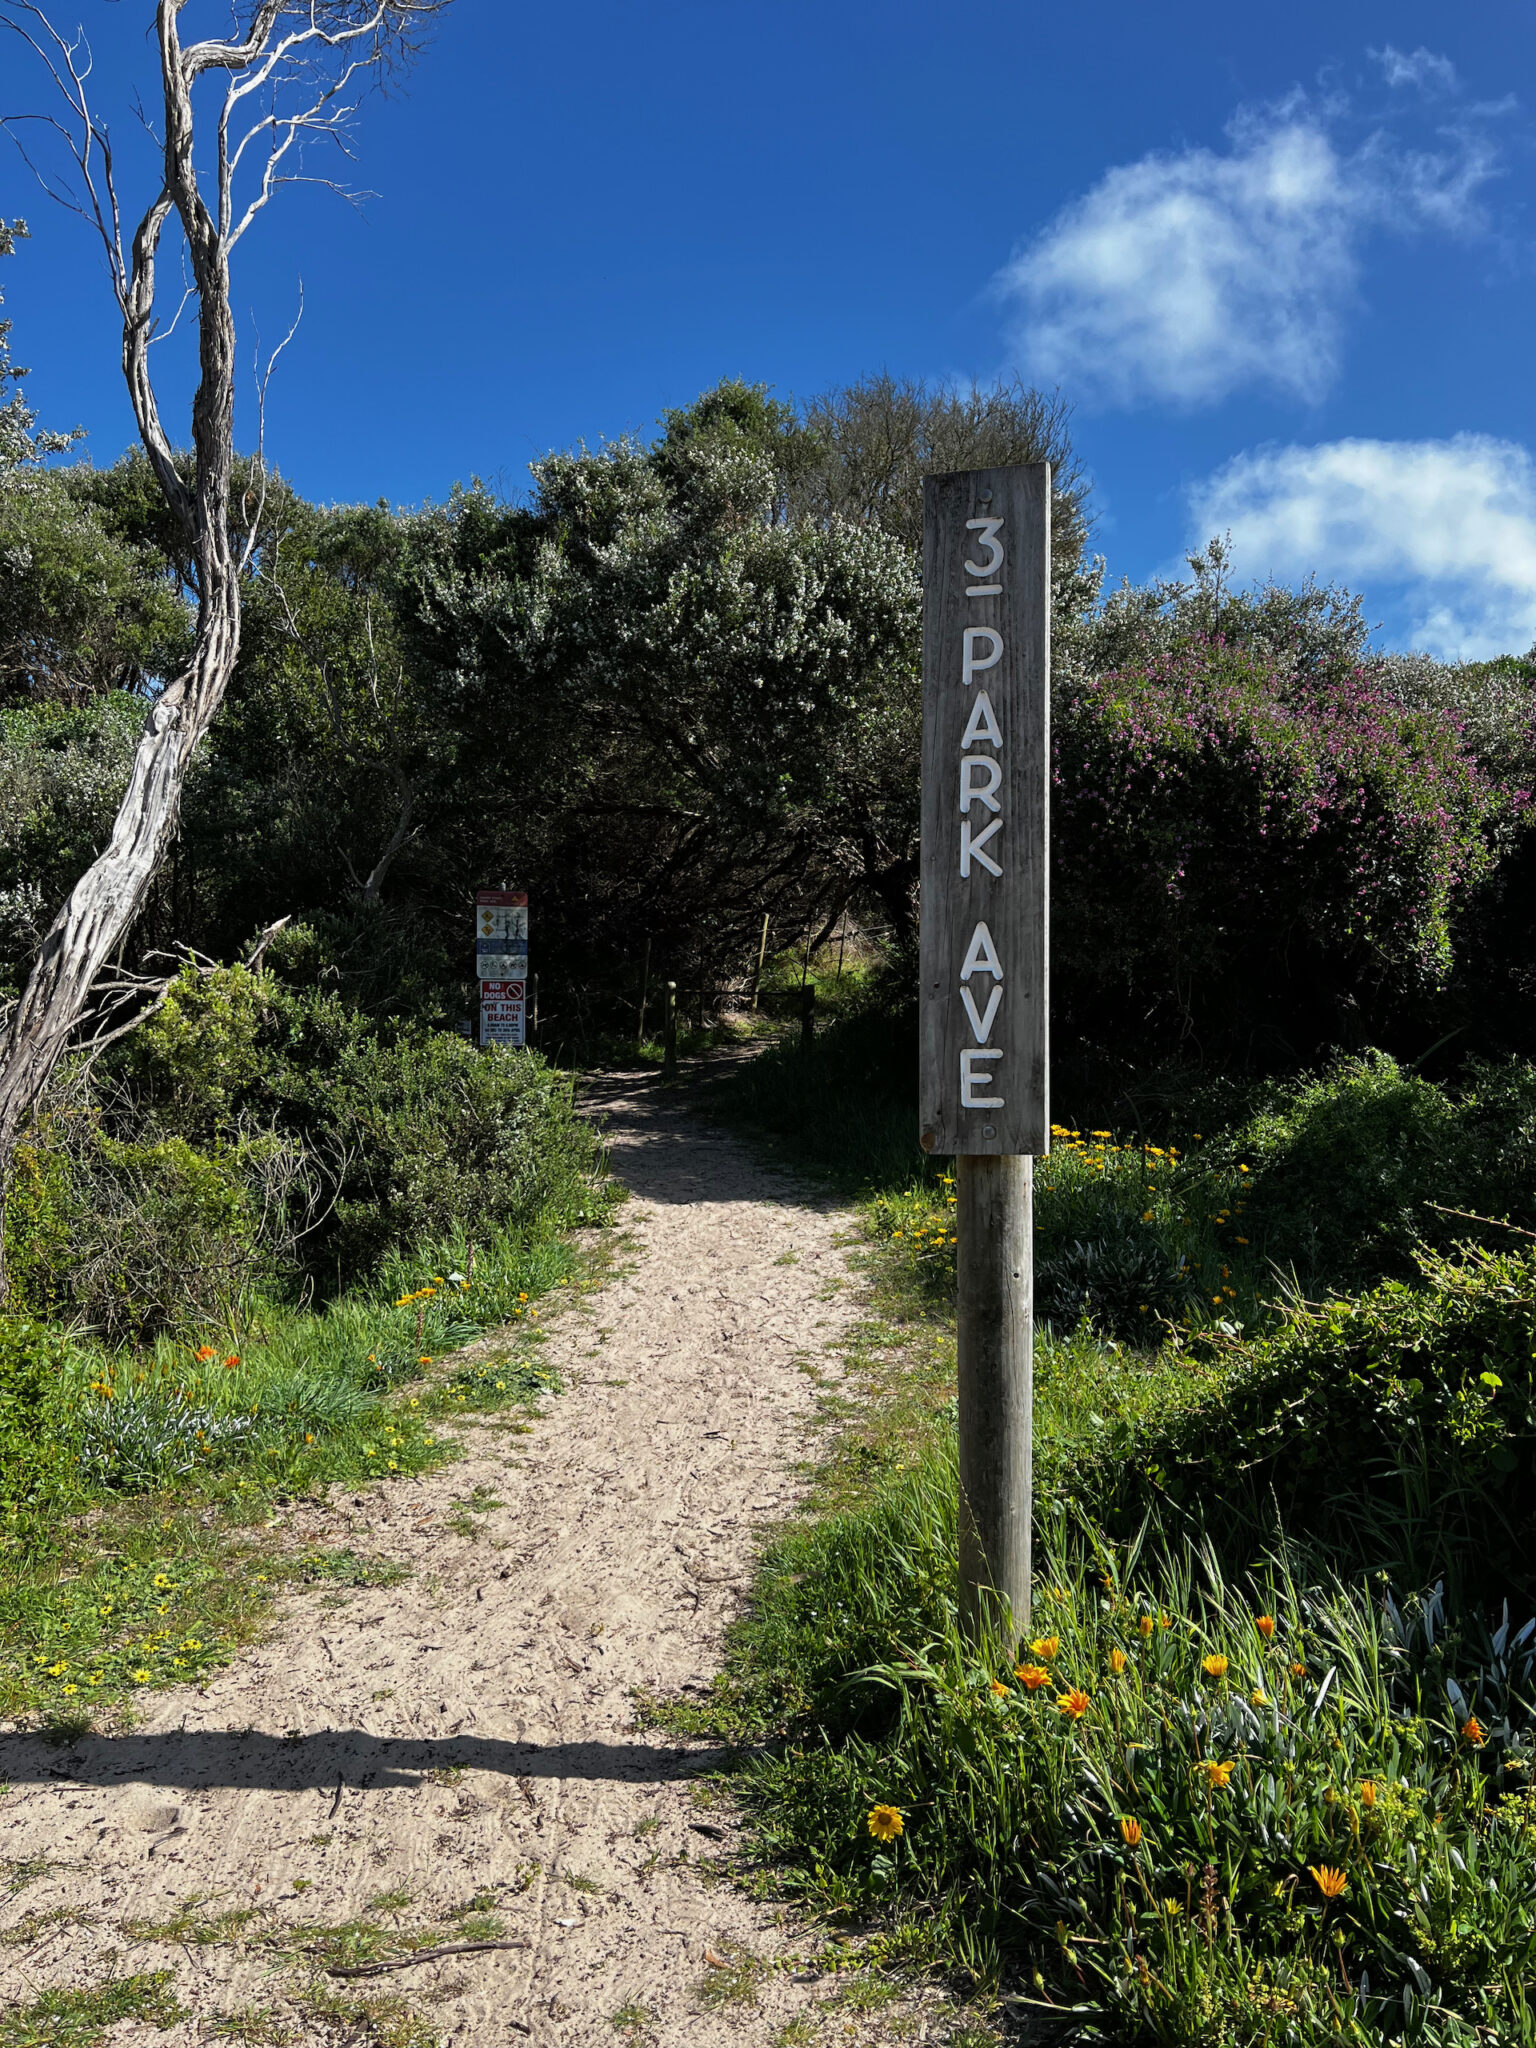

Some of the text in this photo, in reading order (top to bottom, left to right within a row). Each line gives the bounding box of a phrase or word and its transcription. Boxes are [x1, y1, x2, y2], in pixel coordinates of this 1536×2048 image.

[960, 626, 1004, 878] PARK
[484, 1003, 521, 1012] ON THIS
[487, 1013, 518, 1022] BEACH
[959, 920, 1005, 1108] AVE
